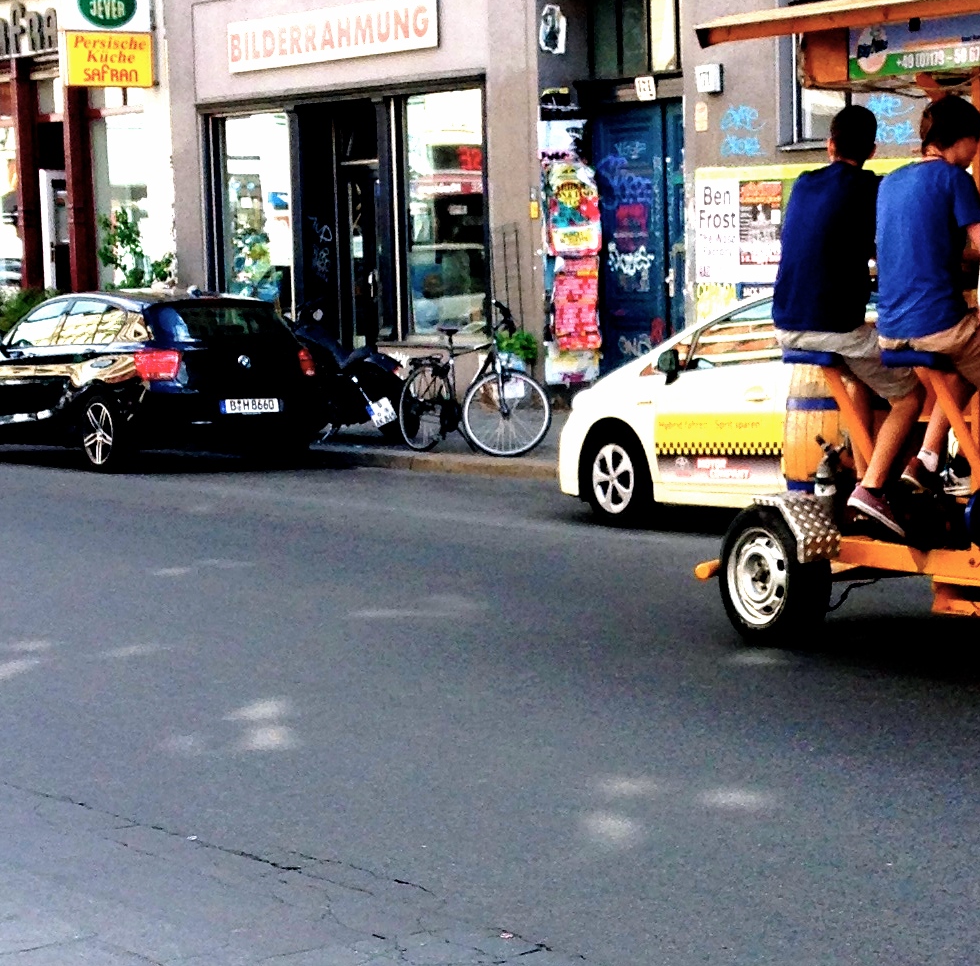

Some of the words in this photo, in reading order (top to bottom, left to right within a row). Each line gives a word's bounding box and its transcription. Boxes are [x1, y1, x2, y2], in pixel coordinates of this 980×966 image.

[73, 35, 147, 51] Persische
[230, 4, 430, 63] BILDERRAHMUNG
[86, 50, 136, 64] Küche
[703, 186, 731, 206] Ben
[699, 209, 736, 229] Frost
